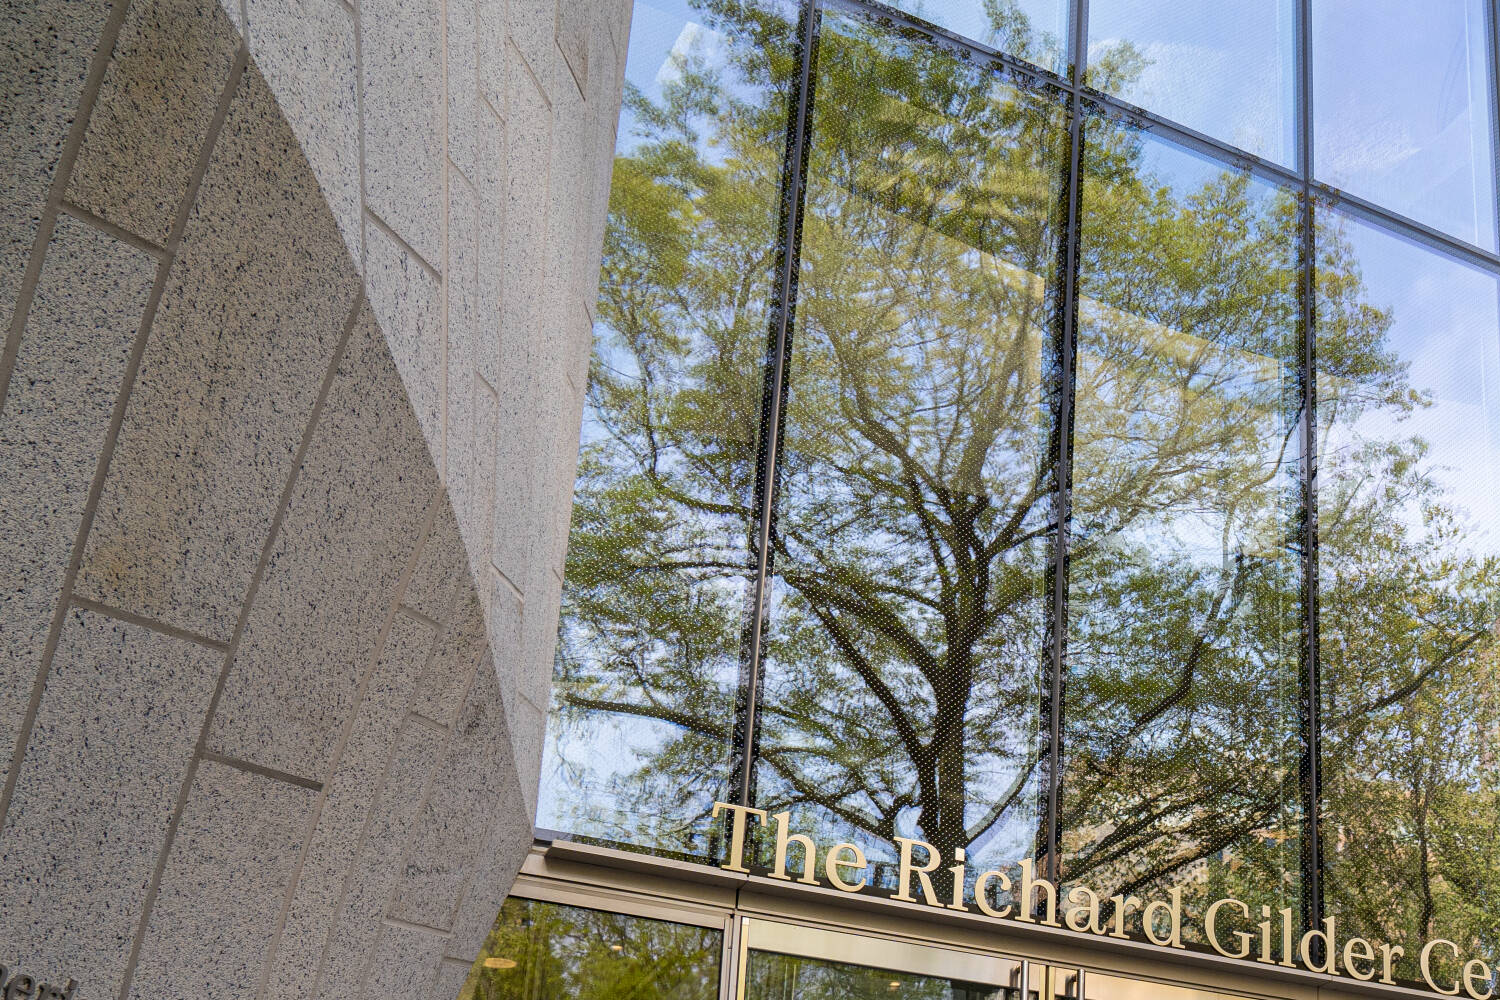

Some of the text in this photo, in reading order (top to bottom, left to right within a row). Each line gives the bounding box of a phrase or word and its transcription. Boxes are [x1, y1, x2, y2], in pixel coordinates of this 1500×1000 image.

[712, 801, 868, 893] The
[890, 836, 1186, 949] Richard
[1204, 898, 1404, 985] Gilder
